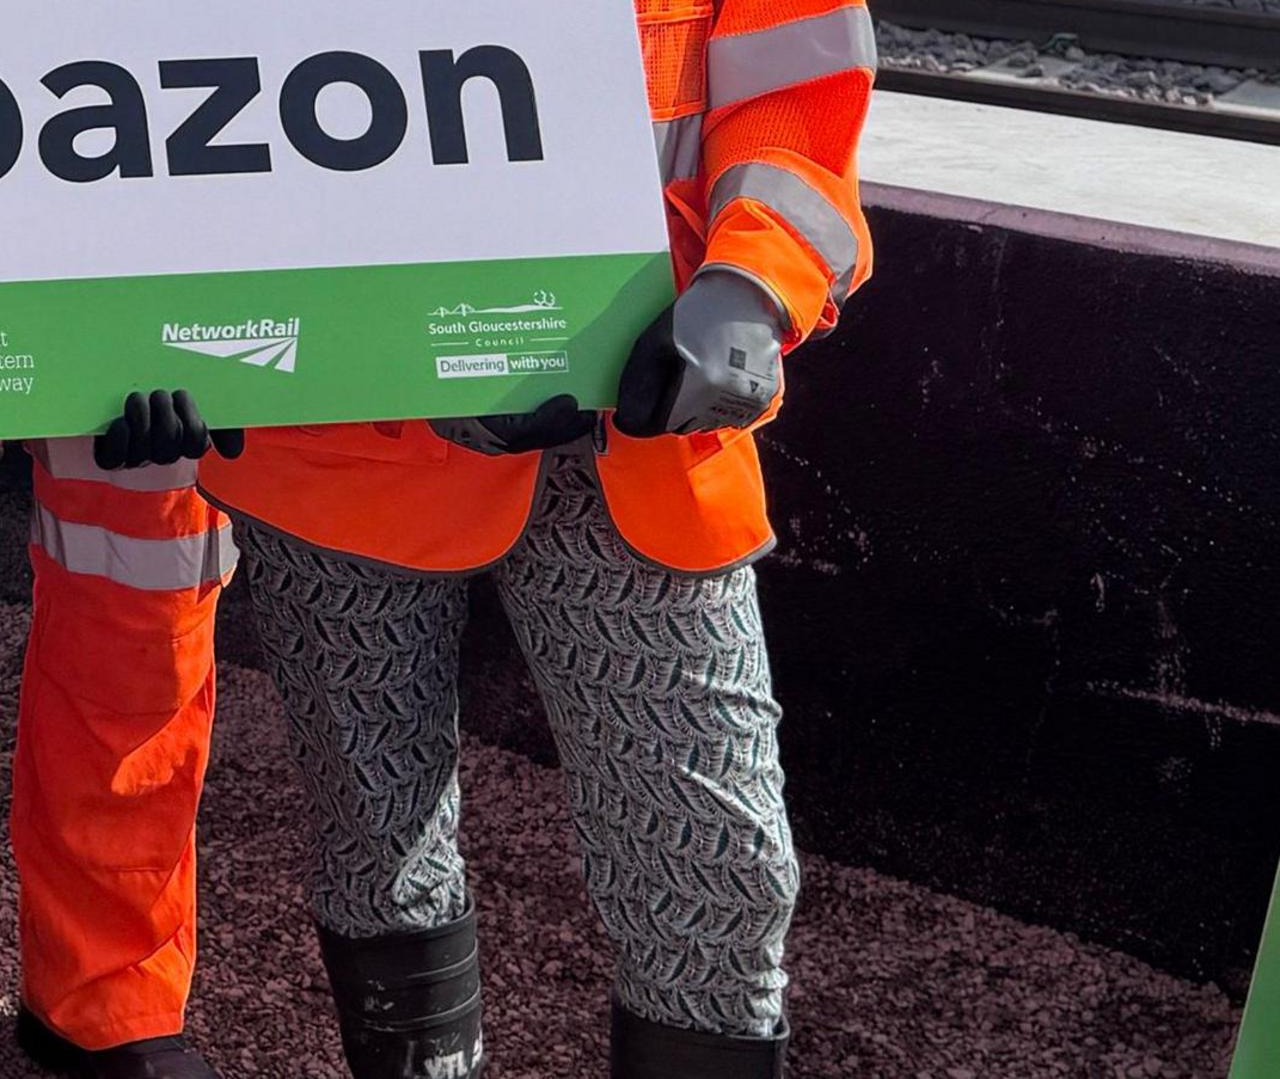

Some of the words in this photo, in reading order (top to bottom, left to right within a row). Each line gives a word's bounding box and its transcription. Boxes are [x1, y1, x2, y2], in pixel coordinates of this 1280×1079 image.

[428, 322, 466, 335] South
[468, 317, 567, 333] Gloucestershire
[475, 337, 525, 347] Council
[440, 357, 505, 373] Delivering
[509, 356, 539, 370] with
[539, 357, 565, 371] you
